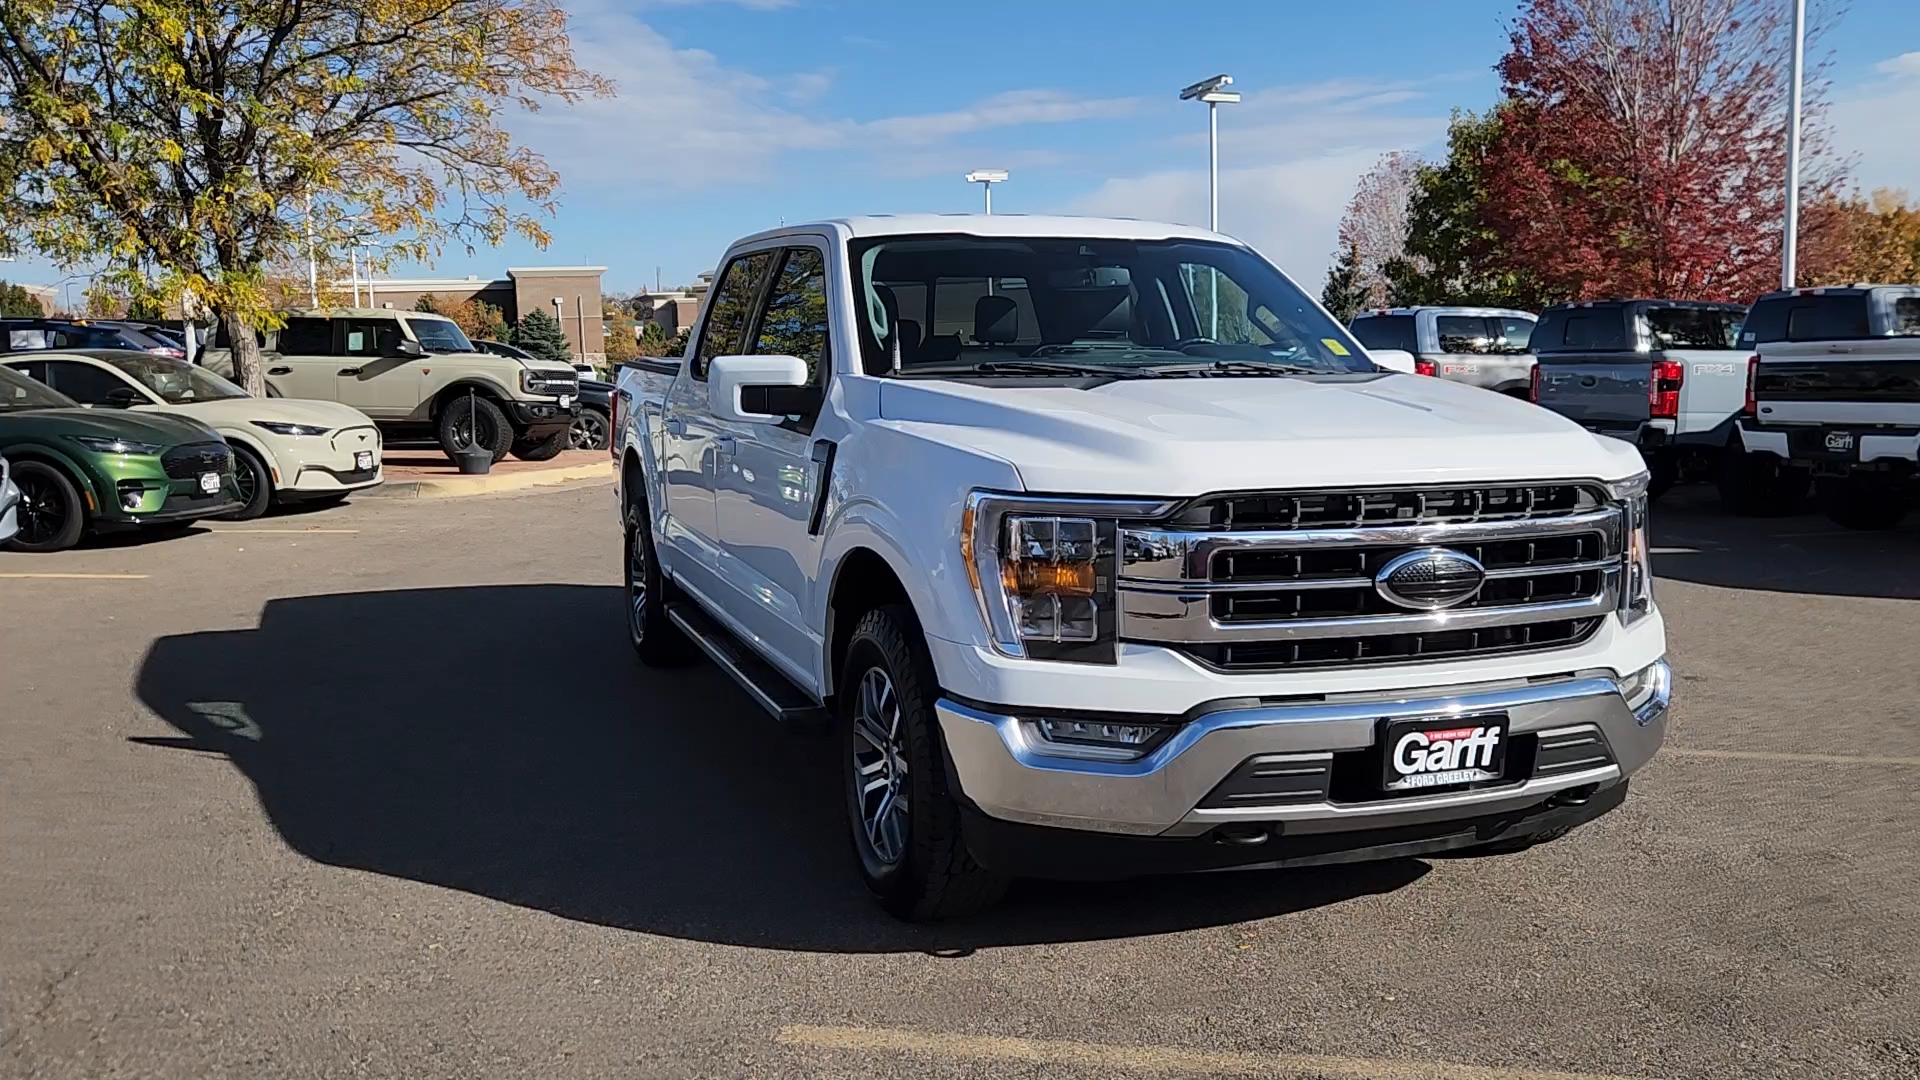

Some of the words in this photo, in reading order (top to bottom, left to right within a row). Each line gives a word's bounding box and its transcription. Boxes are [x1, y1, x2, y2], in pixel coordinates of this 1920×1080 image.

[1444, 364, 1479, 375] FX4
[1694, 364, 1735, 375] FX4
[1393, 726, 1501, 774] Garff
[1411, 776, 1435, 787] FORD
[1436, 772, 1474, 785] GREELEY
